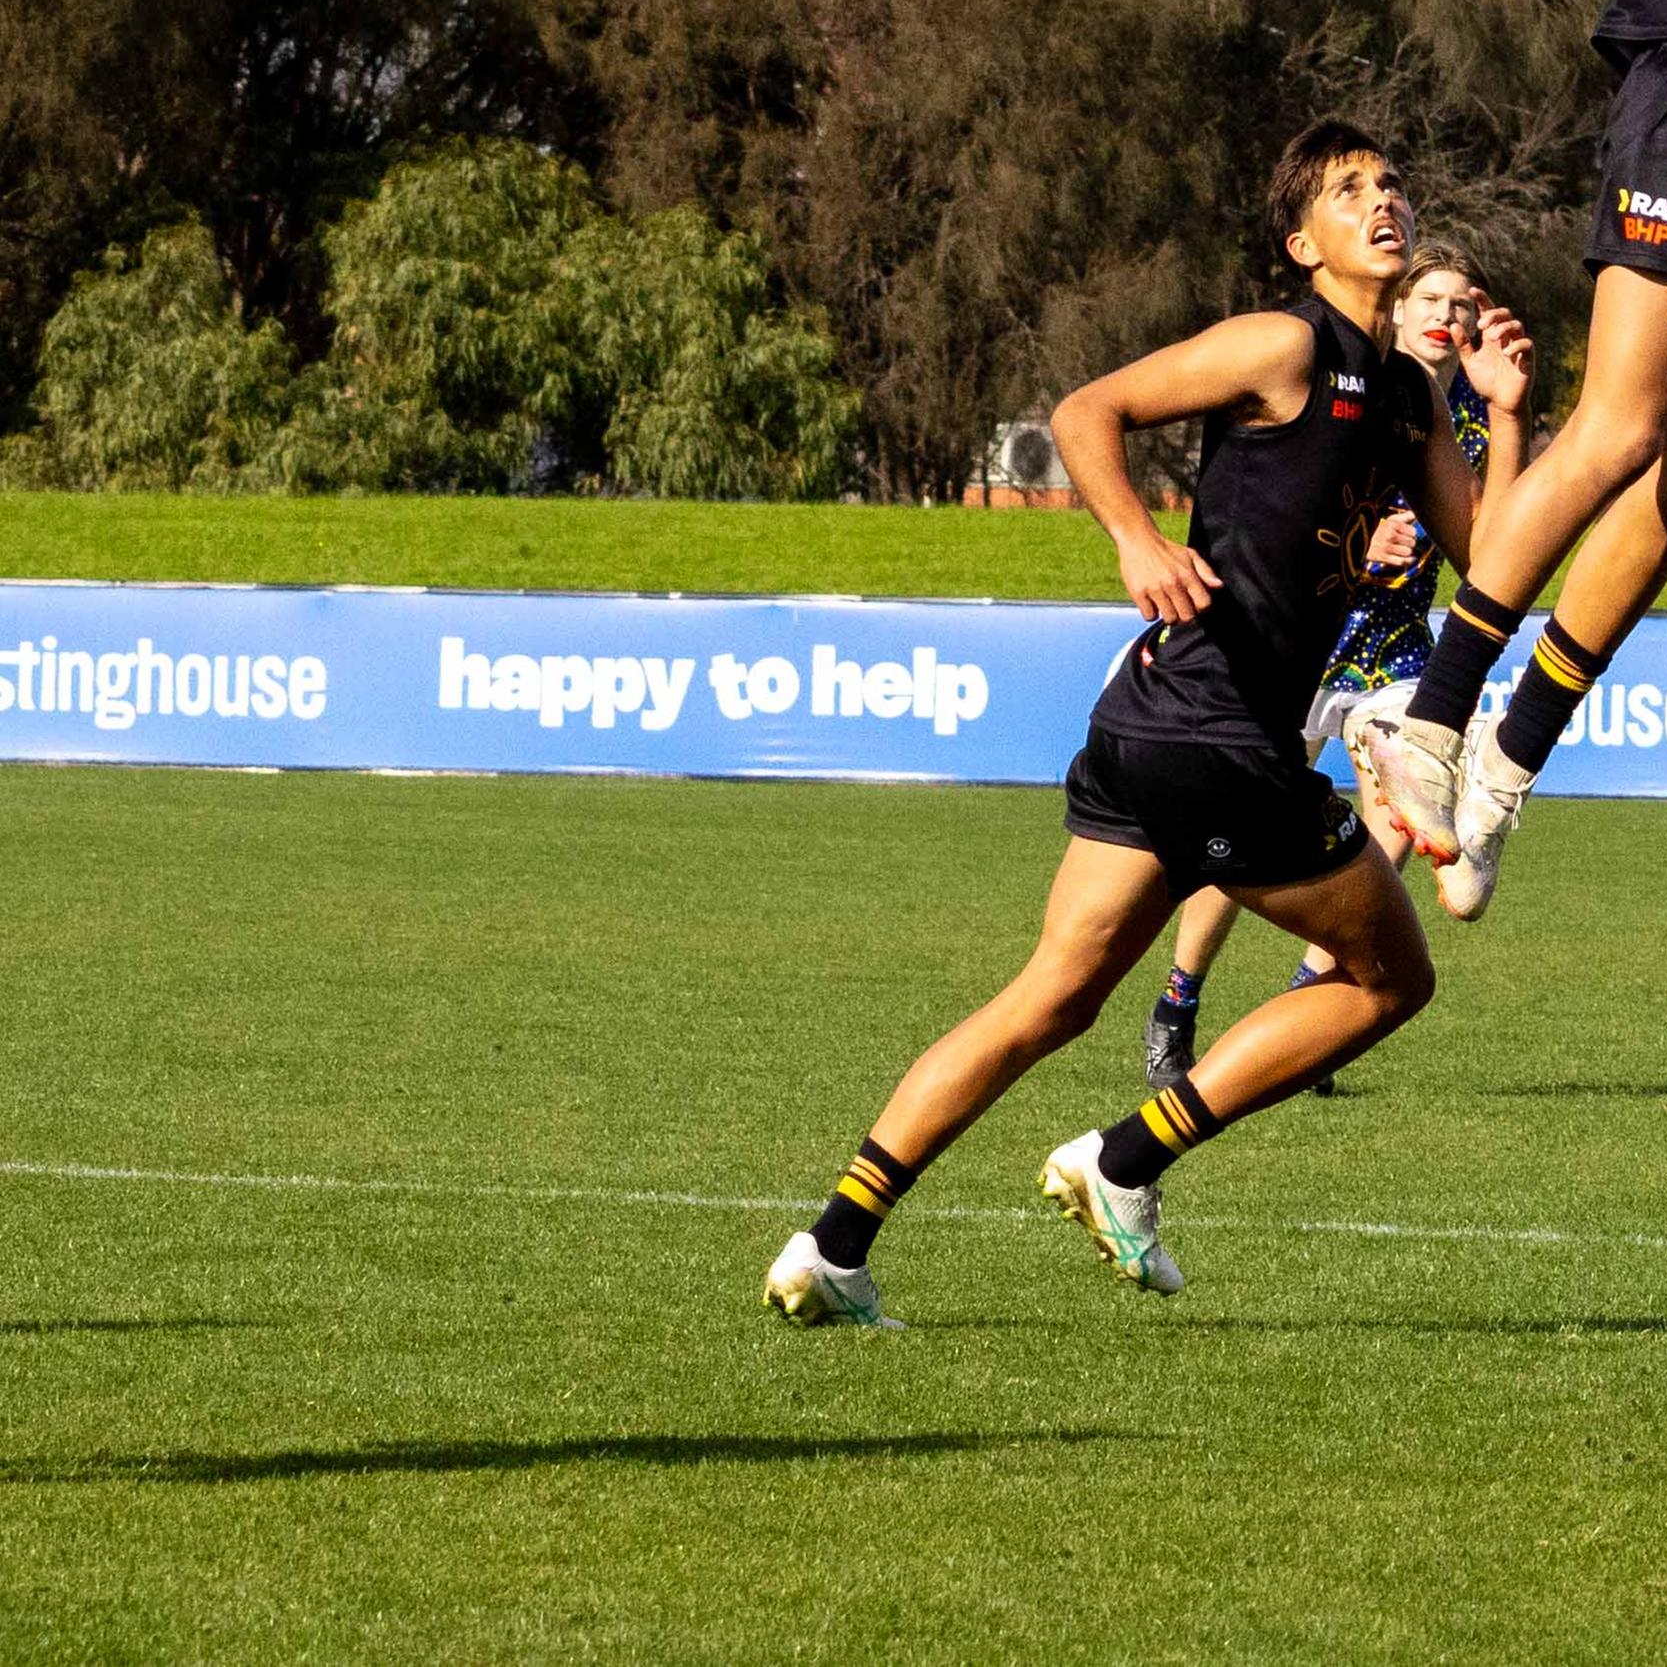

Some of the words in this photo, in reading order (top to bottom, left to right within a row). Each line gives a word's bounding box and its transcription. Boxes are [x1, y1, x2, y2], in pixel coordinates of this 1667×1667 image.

[439, 637, 696, 730] happy
[708, 652, 800, 719] to
[811, 644, 988, 735] help
